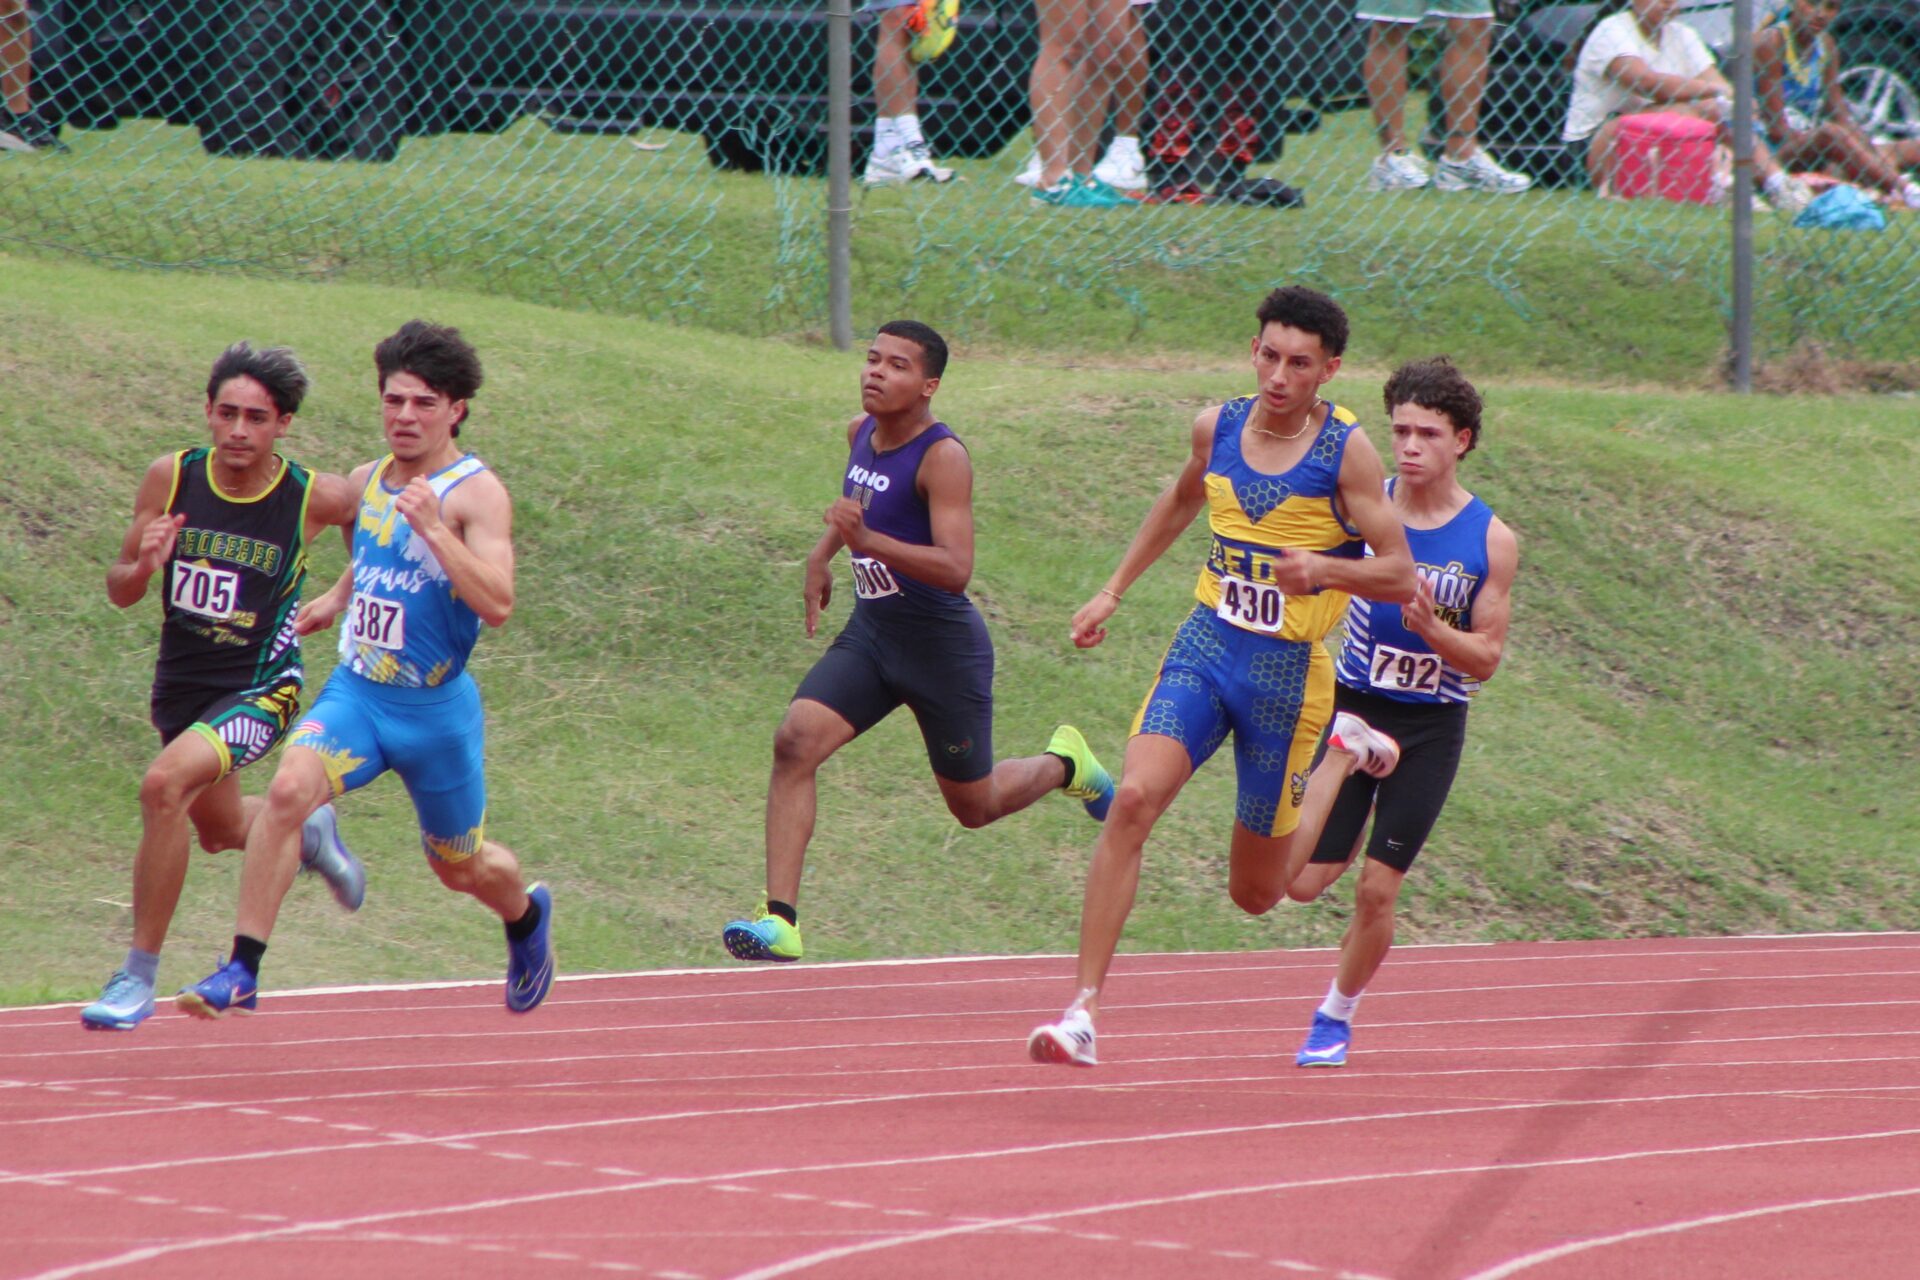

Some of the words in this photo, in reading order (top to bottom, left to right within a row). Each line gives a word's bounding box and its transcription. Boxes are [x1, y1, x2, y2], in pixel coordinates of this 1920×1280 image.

[174, 566, 234, 613] 705
[1225, 581, 1280, 626] 430
[354, 598, 399, 643] 387
[1373, 650, 1438, 689] 792
